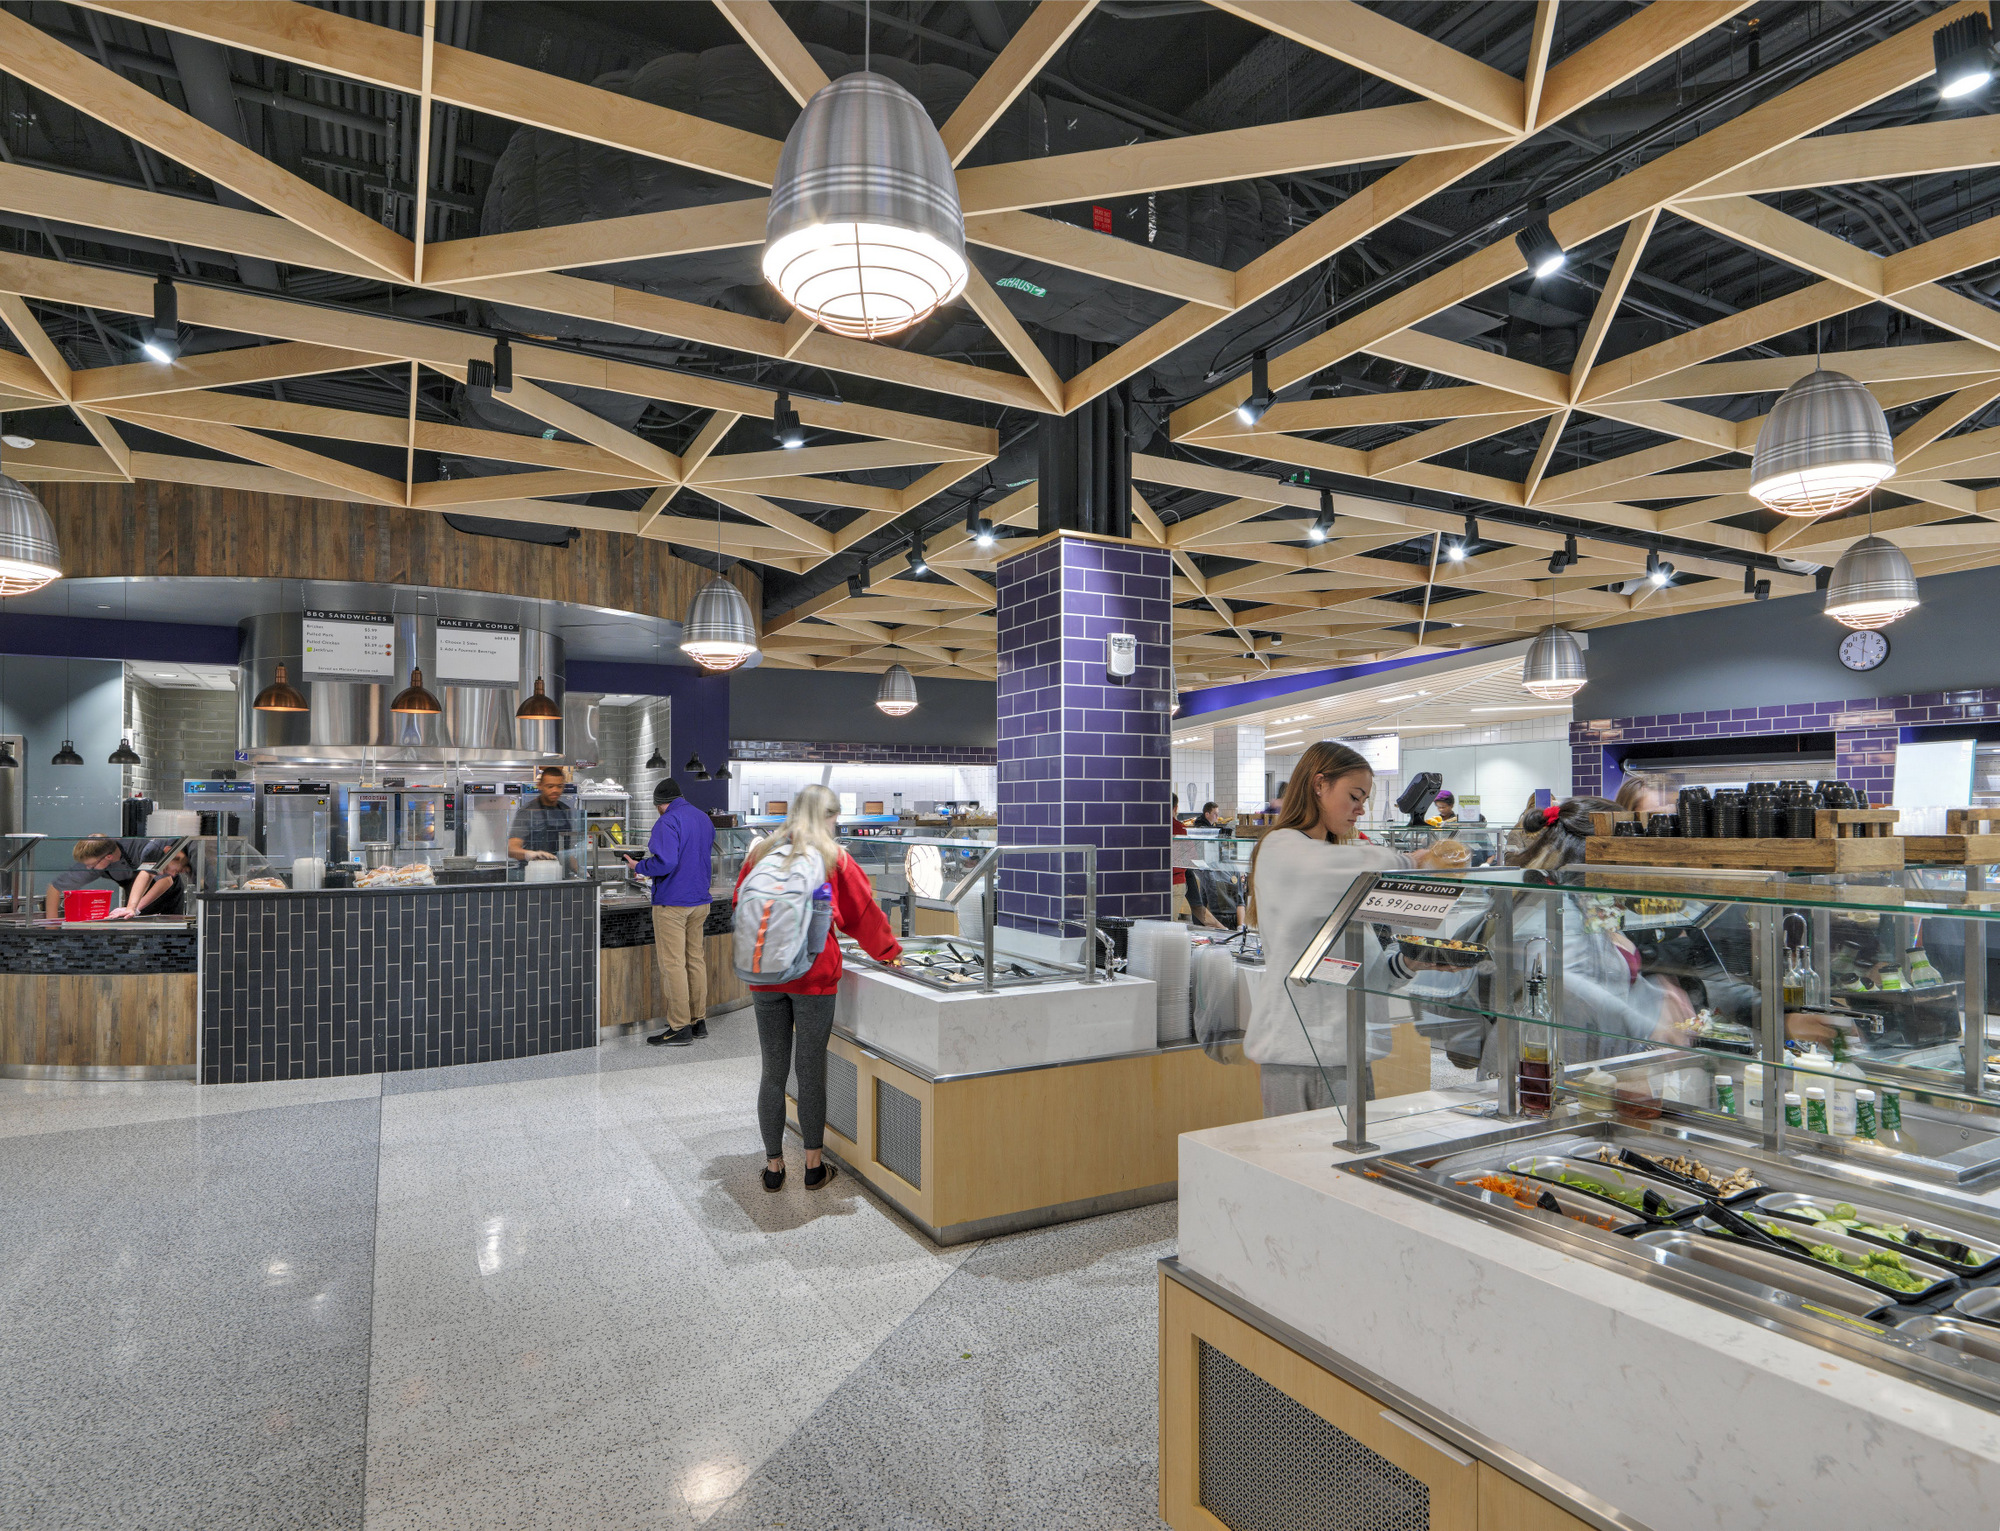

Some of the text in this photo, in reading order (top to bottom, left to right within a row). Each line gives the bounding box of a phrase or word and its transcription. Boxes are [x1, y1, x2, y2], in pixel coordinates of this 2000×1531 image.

[995, 277, 1038, 294] EXHAUST
[329, 612, 387, 621] SANDWICHES
[1397, 883, 1417, 891] THE
[1419, 885, 1456, 894] POUND
[1366, 897, 1449, 913] $6.99/pound
